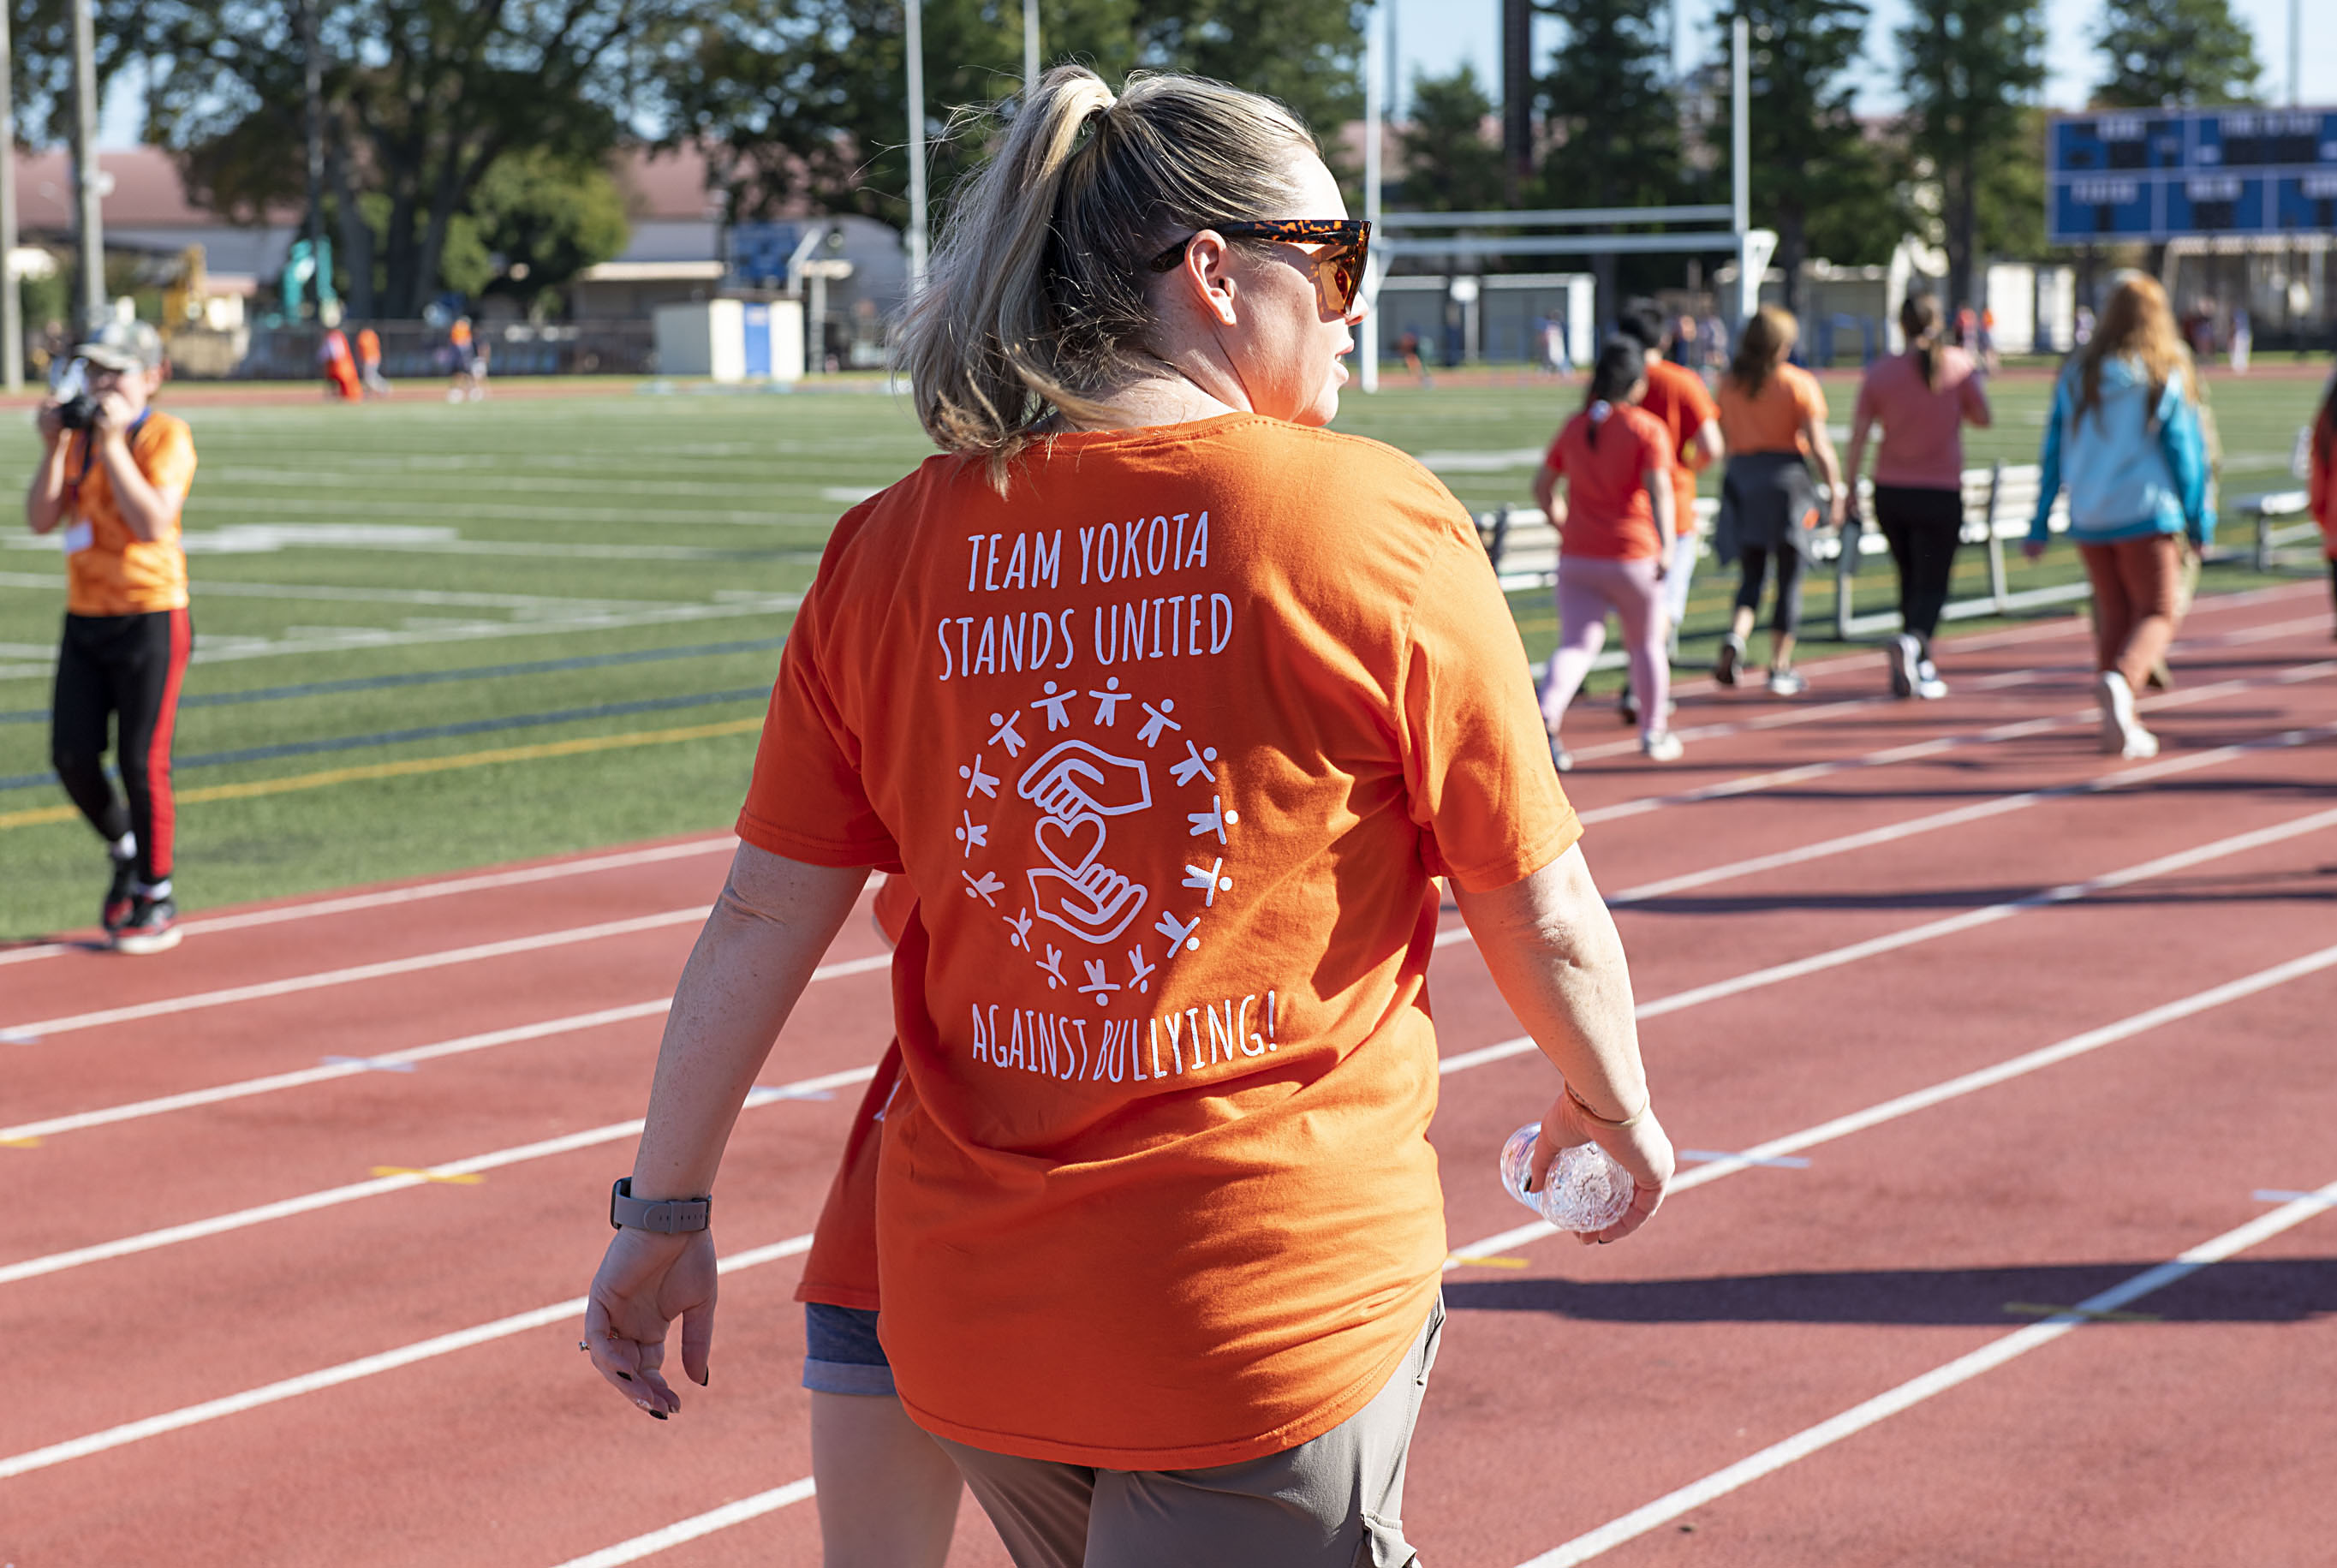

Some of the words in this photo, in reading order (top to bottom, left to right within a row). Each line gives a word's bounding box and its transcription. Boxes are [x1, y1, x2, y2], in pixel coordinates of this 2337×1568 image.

[968, 529, 1062, 592] TEAM
[1080, 511, 1209, 585] YOKOTA
[938, 609, 1075, 682] STANDS
[1094, 593, 1233, 665] UNITED
[971, 1004, 1088, 1082] AGAINST
[1093, 991, 1278, 1082] BULLYING!
